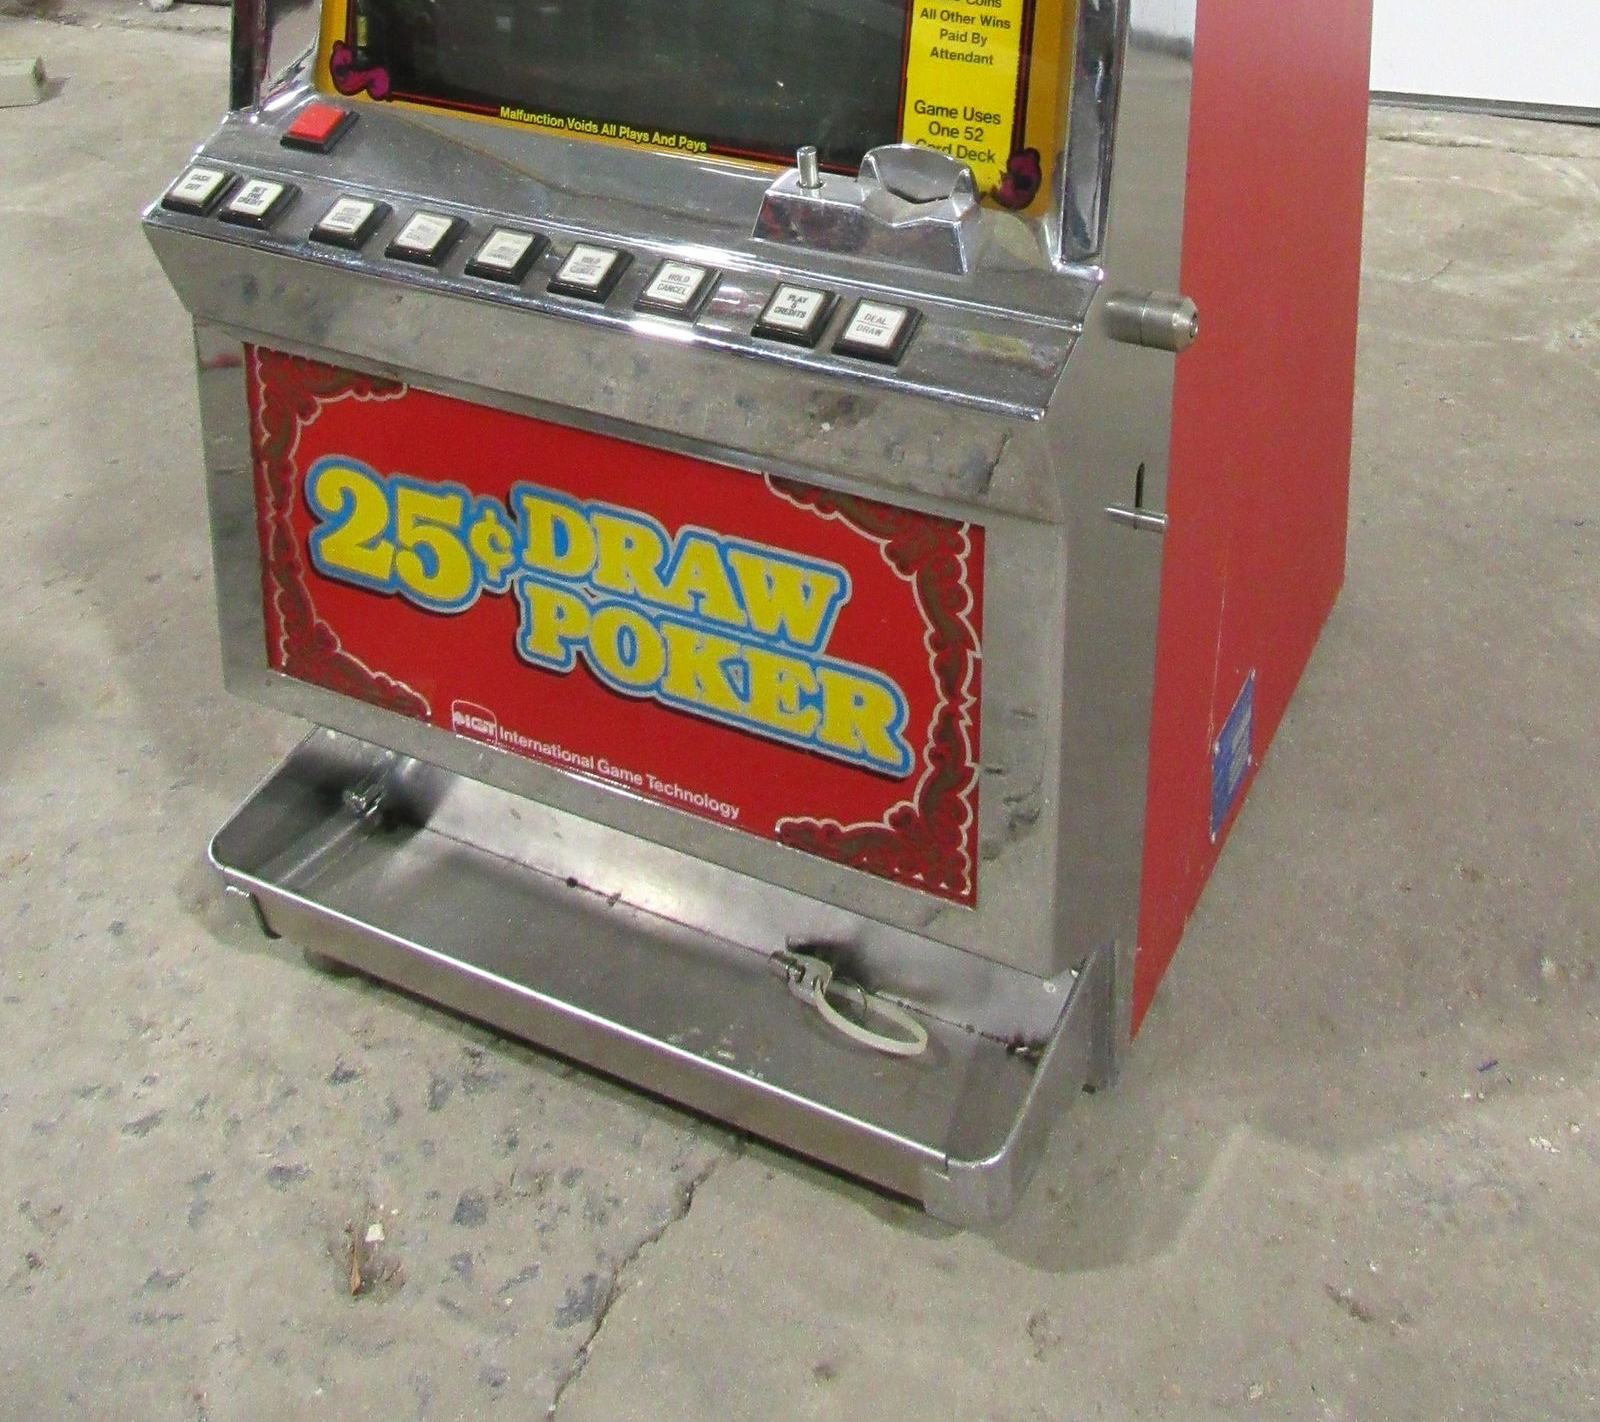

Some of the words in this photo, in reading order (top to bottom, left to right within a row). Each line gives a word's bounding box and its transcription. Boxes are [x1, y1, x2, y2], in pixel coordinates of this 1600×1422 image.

[920, 8, 936, 20] All
[940, 10, 975, 25] Other
[980, 15, 1011, 29] Wins
[940, 29, 967, 43] Paid
[971, 32, 987, 47] By
[929, 46, 994, 66] Attendant
[914, 99, 958, 119] Game
[963, 106, 1001, 125] Uses
[500, 106, 564, 128] Malfunction
[567, 117, 599, 135] Voids
[600, 122, 616, 136] All
[619, 125, 650, 144] Plays
[651, 131, 676, 148] And
[678, 136, 707, 153] Pays
[928, 121, 960, 138] One
[964, 126, 984, 142] 52
[957, 144, 996, 163] Deck
[667, 273, 691, 283] HOLD
[656, 282, 687, 296] CANCEL
[787, 294, 809, 304] PLAY
[773, 307, 807, 318] CREDITS
[864, 313, 887, 325] DEAL
[856, 324, 884, 337] DRAW
[308, 456, 517, 611] 25¢
[513, 483, 849, 651] DRAW
[518, 577, 911, 775] POKER
[499, 726, 595, 768] International
[597, 759, 643, 787] Game
[646, 774, 740, 821] Technology
